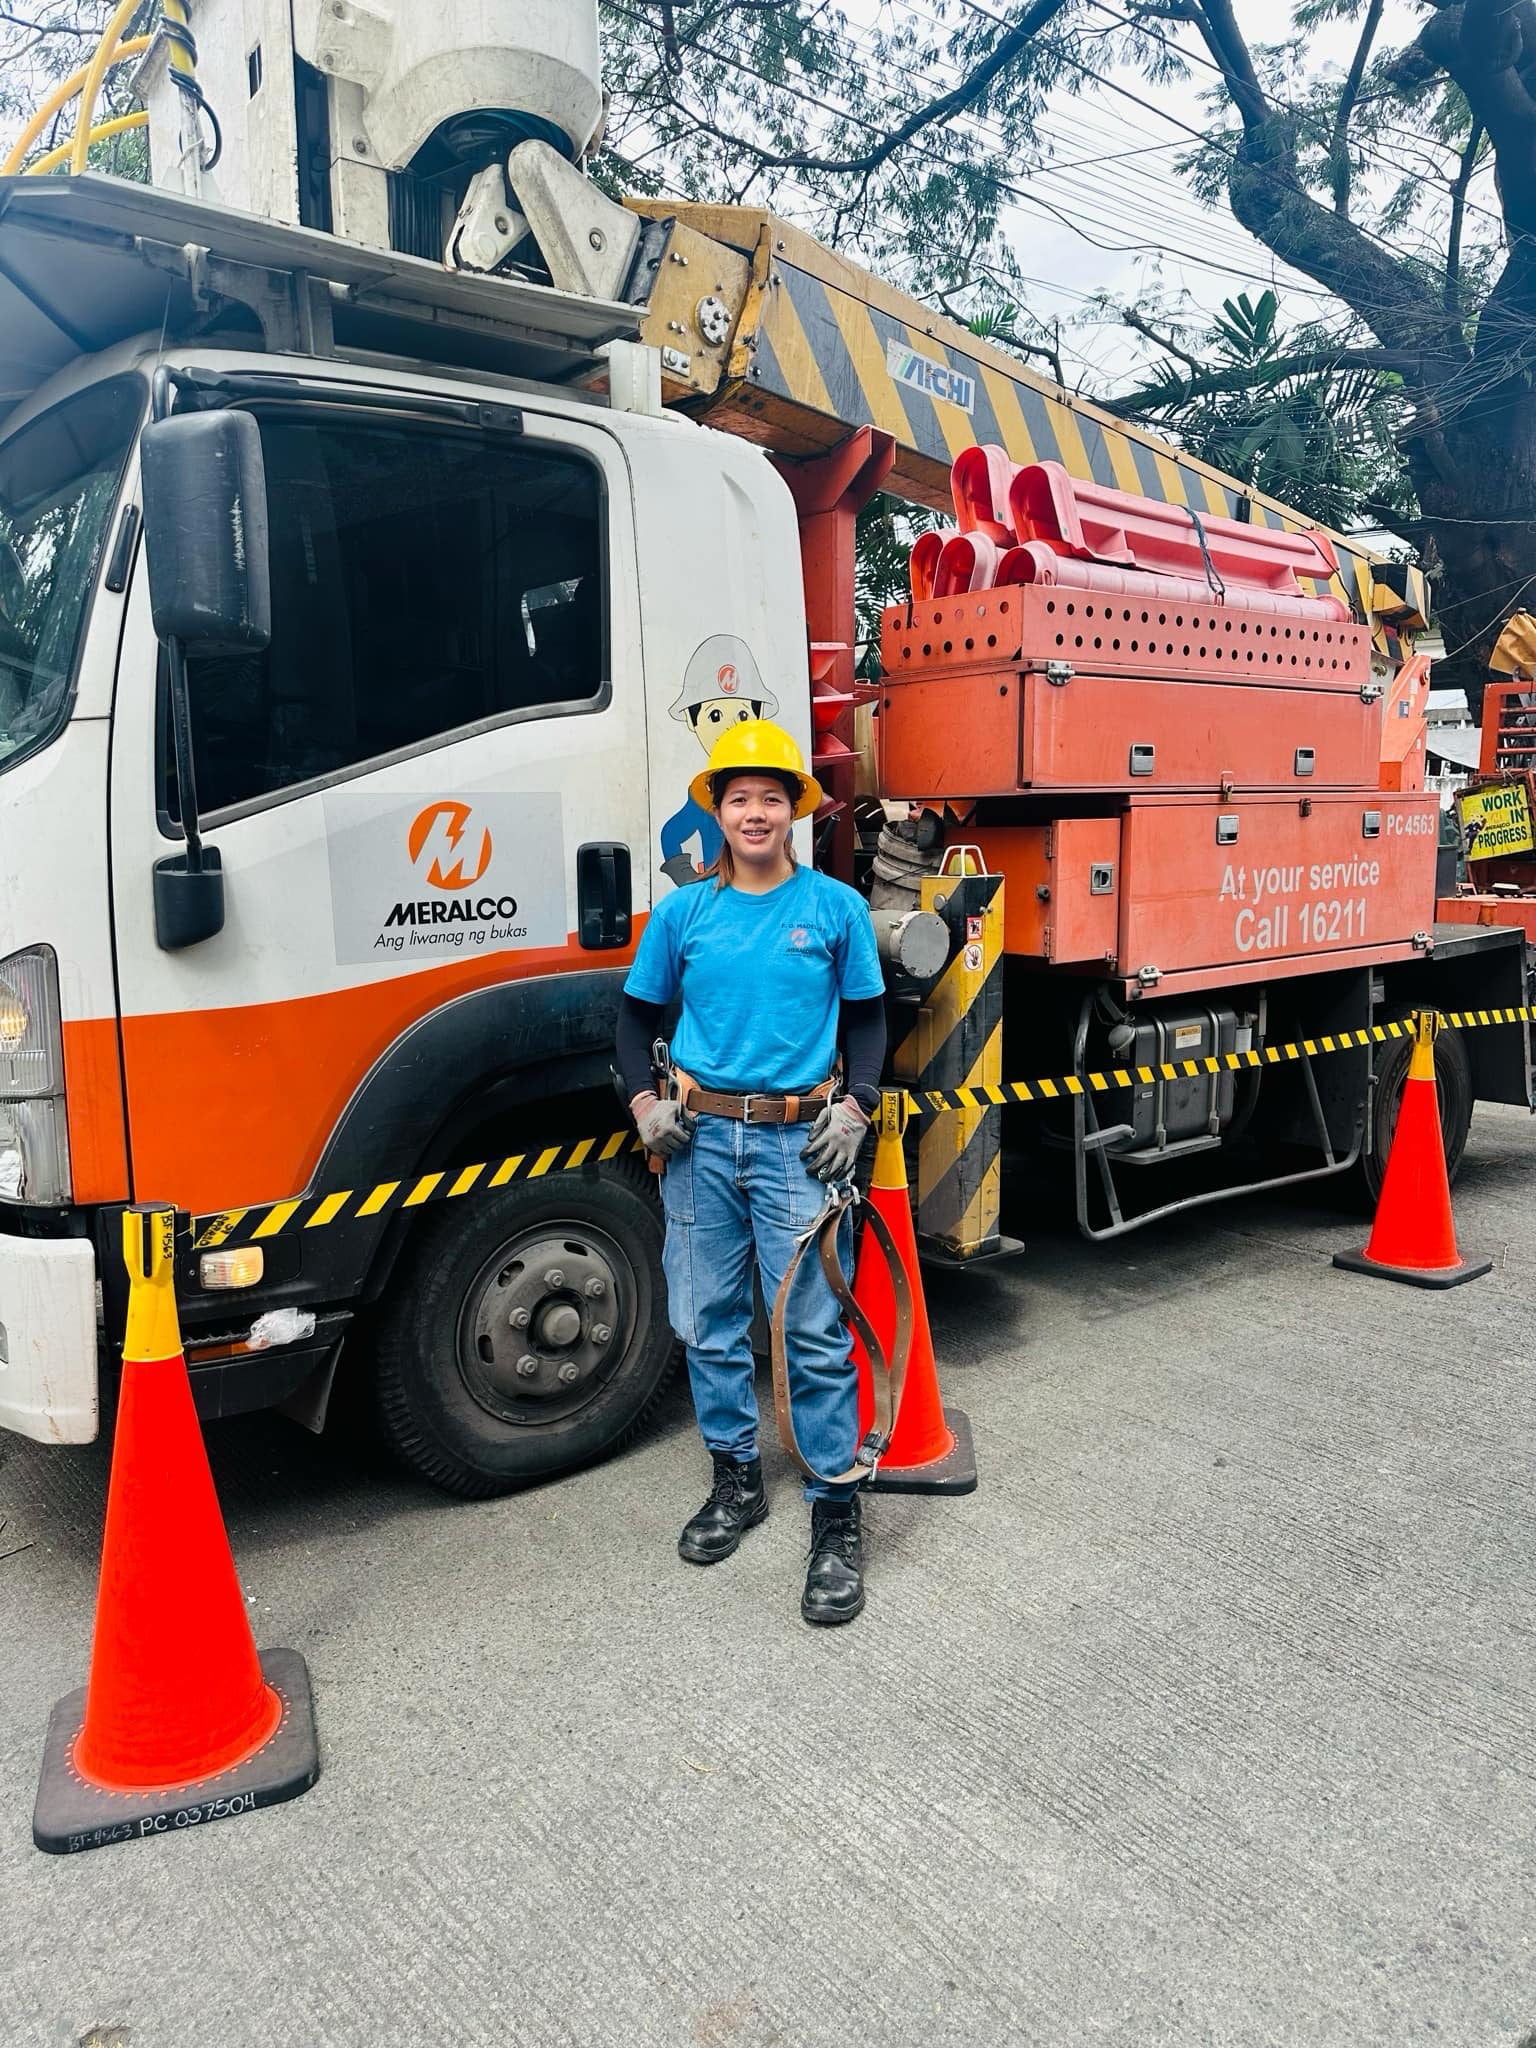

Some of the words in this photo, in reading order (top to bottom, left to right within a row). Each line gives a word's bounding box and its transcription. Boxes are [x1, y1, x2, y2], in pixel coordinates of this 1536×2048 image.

[903, 354, 971, 409] AICHI
[1481, 791, 1523, 812] WORK
[1510, 807, 1526, 824] IN
[1478, 826, 1528, 849] PROGRESS
[1218, 864, 1246, 901] At
[1252, 865, 1304, 904] your
[1309, 854, 1380, 891] service
[384, 896, 517, 927] MERALCO
[1234, 905, 1289, 951] Call
[1298, 897, 1367, 944] 16211
[374, 933, 404, 951] Ang
[409, 930, 464, 946] liwanag
[469, 930, 486, 945] ng
[490, 922, 528, 939] bukas
